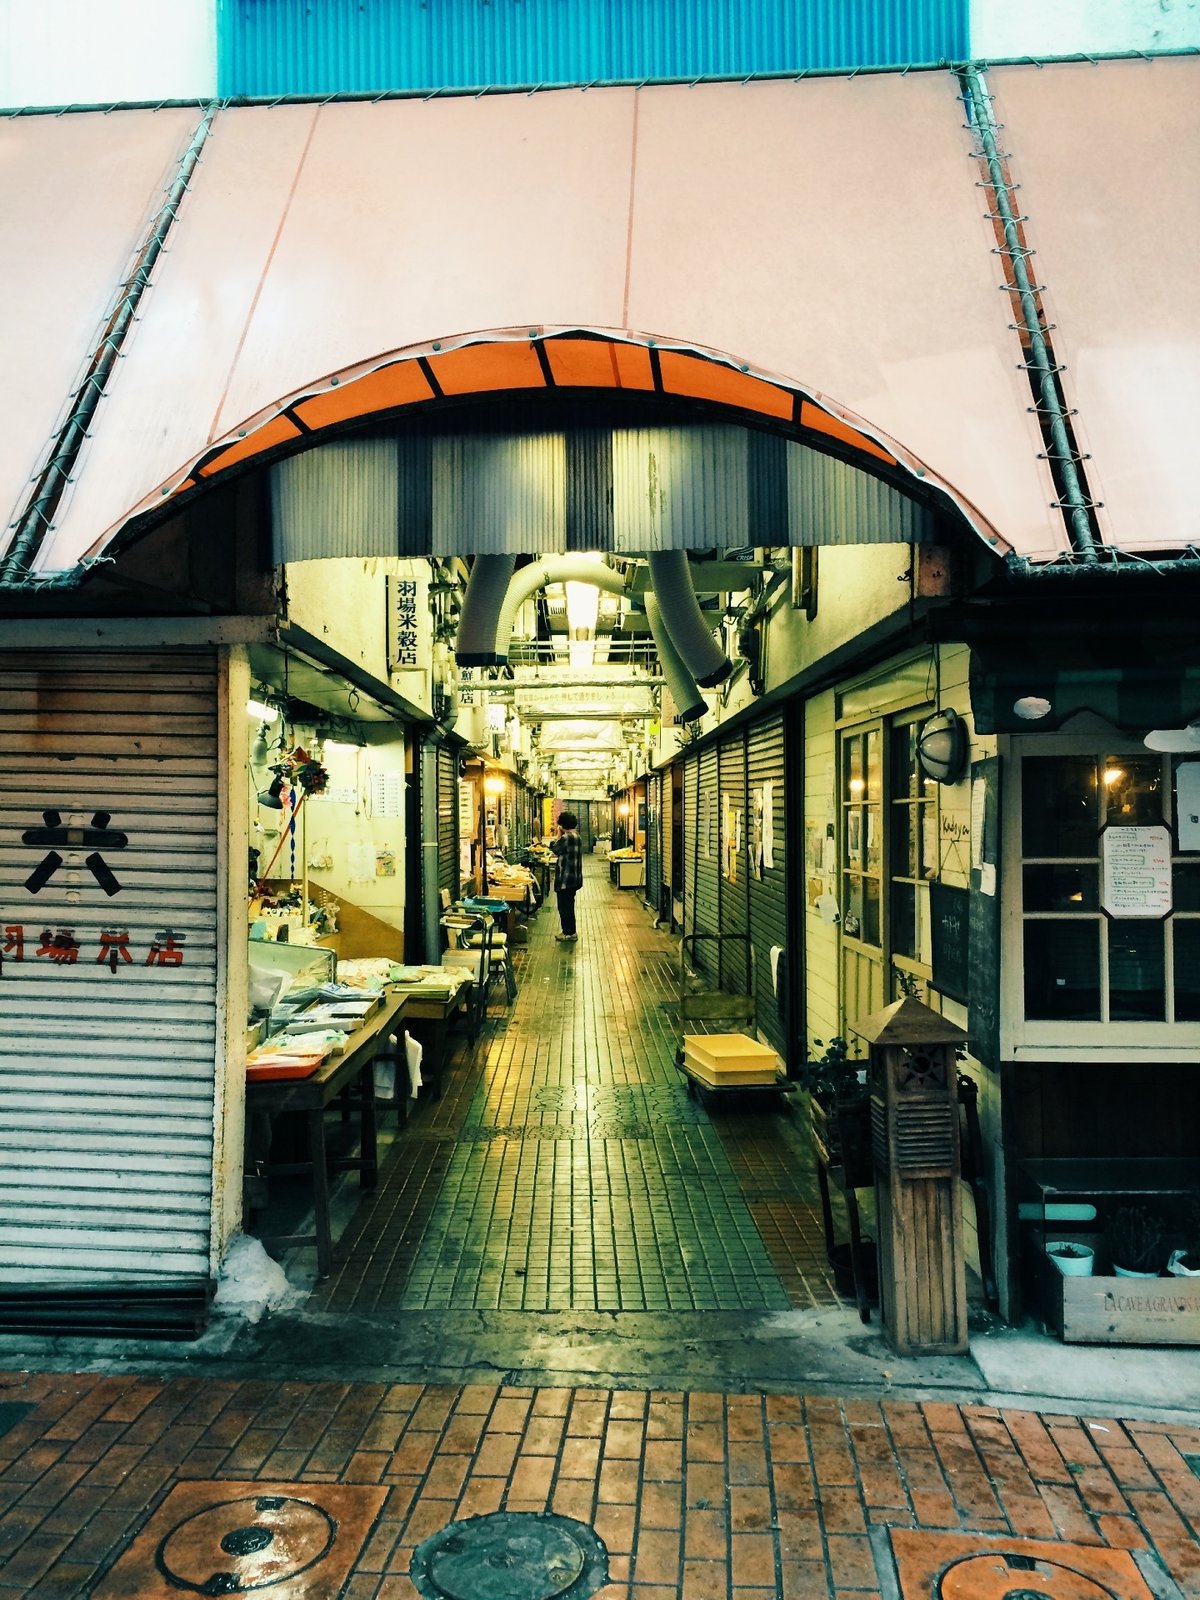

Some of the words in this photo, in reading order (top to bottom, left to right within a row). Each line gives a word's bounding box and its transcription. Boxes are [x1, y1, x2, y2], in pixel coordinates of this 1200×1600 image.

[396, 580, 418, 665] 羽場米穀店
[460, 666, 474, 704] 鮮店
